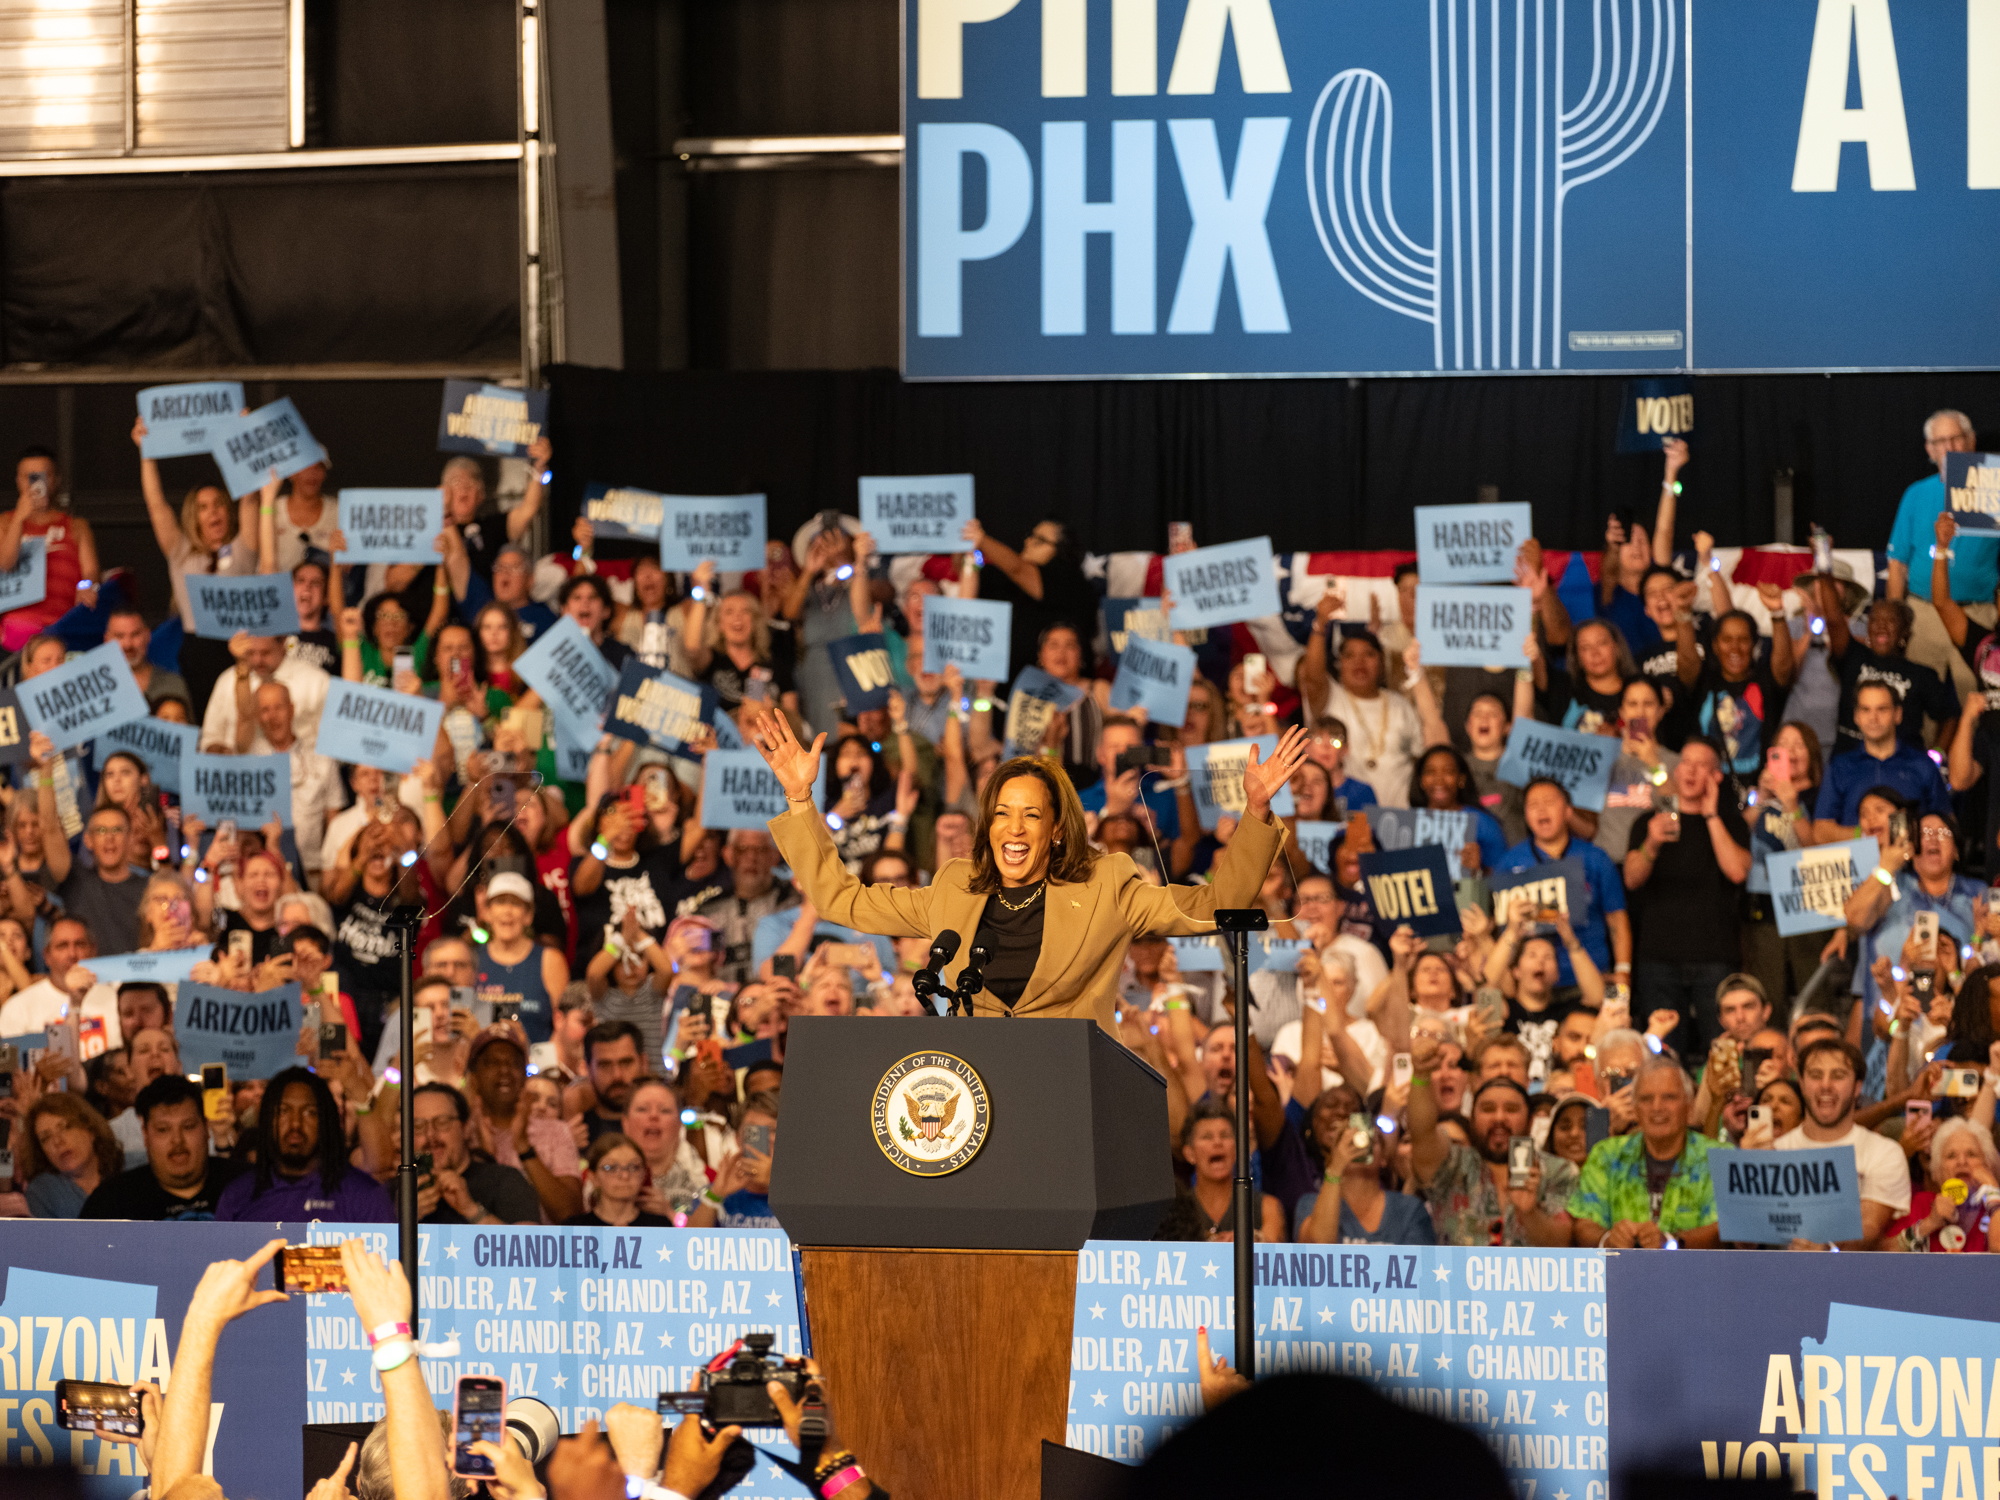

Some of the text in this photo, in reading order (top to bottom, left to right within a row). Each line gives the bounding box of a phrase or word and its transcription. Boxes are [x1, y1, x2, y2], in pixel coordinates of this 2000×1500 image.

[918, 117, 1292, 337] PHX
[150, 388, 234, 421] ARIZONA
[1636, 394, 1694, 435] VOTE!
[247, 444, 300, 474] WALZ
[350, 503, 428, 532] HARRIS
[876, 492, 957, 520] HARRIS
[675, 511, 752, 538] HARRIS
[889, 522, 946, 538] WALZ
[1433, 519, 1514, 550] HARRIS
[361, 534, 415, 550] WALZ
[686, 541, 742, 557] WALZ
[1447, 550, 1502, 568] WALZ
[1177, 557, 1259, 597] HARRIS
[200, 586, 281, 612] HARRIS
[1194, 588, 1251, 612] WALZ
[215, 611, 272, 629] WALZ
[929, 612, 995, 646] HARRIS
[1432, 601, 1514, 633] HARRIS
[1443, 633, 1502, 651] WALZ
[35, 664, 118, 721] HARRIS
[547, 668, 589, 718] WALZ
[57, 697, 116, 732] WALZ
[337, 692, 426, 736] ARIZONA
[1521, 735, 1602, 776] HARRIS
[196, 769, 275, 798] HARRIS
[205, 799, 263, 816] WALZ
[1790, 857, 1859, 889] ARIZONA
[1368, 867, 1438, 921] VOTE!
[1780, 887, 1827, 916] VOTES
[186, 997, 291, 1035] ARIZONA
[912, 1056, 926, 1068] OF
[931, 1055, 951, 1068] THE
[875, 1062, 907, 1136] PRESIDENT
[955, 1063, 987, 1114] UNITED
[884, 1139, 910, 1169] VICE
[949, 1122, 986, 1168] STATES
[1728, 1160, 1841, 1196] ARIZONA
[418, 1233, 430, 1266] Z
[474, 1233, 607, 1274] CHANDLER,
[612, 1236, 642, 1269] AZ
[1155, 1251, 1187, 1285] AZ
[1385, 1255, 1418, 1288] AZ
[1466, 1255, 1605, 1293] CHANDLER
[507, 1277, 537, 1311] AZ
[581, 1278, 717, 1319] CHANDLER,
[721, 1281, 751, 1314] AZ
[1121, 1294, 1267, 1336] CHANDLE,
[1271, 1297, 1303, 1331] AZ
[1351, 1298, 1498, 1340] CHANDLER,
[1502, 1301, 1535, 1336] AZ
[475, 1319, 610, 1360] CHANDLER,
[614, 1322, 644, 1355] AZ
[1157, 1339, 1189, 1373] AZ
[1387, 1343, 1419, 1377] AZ
[1467, 1344, 1606, 1381] CHANDLER
[508, 1363, 538, 1395] AZ
[582, 1364, 700, 1398] CHANDLE
[1123, 1381, 1204, 1416] CHAN
[1503, 1389, 1537, 1425] AZ
